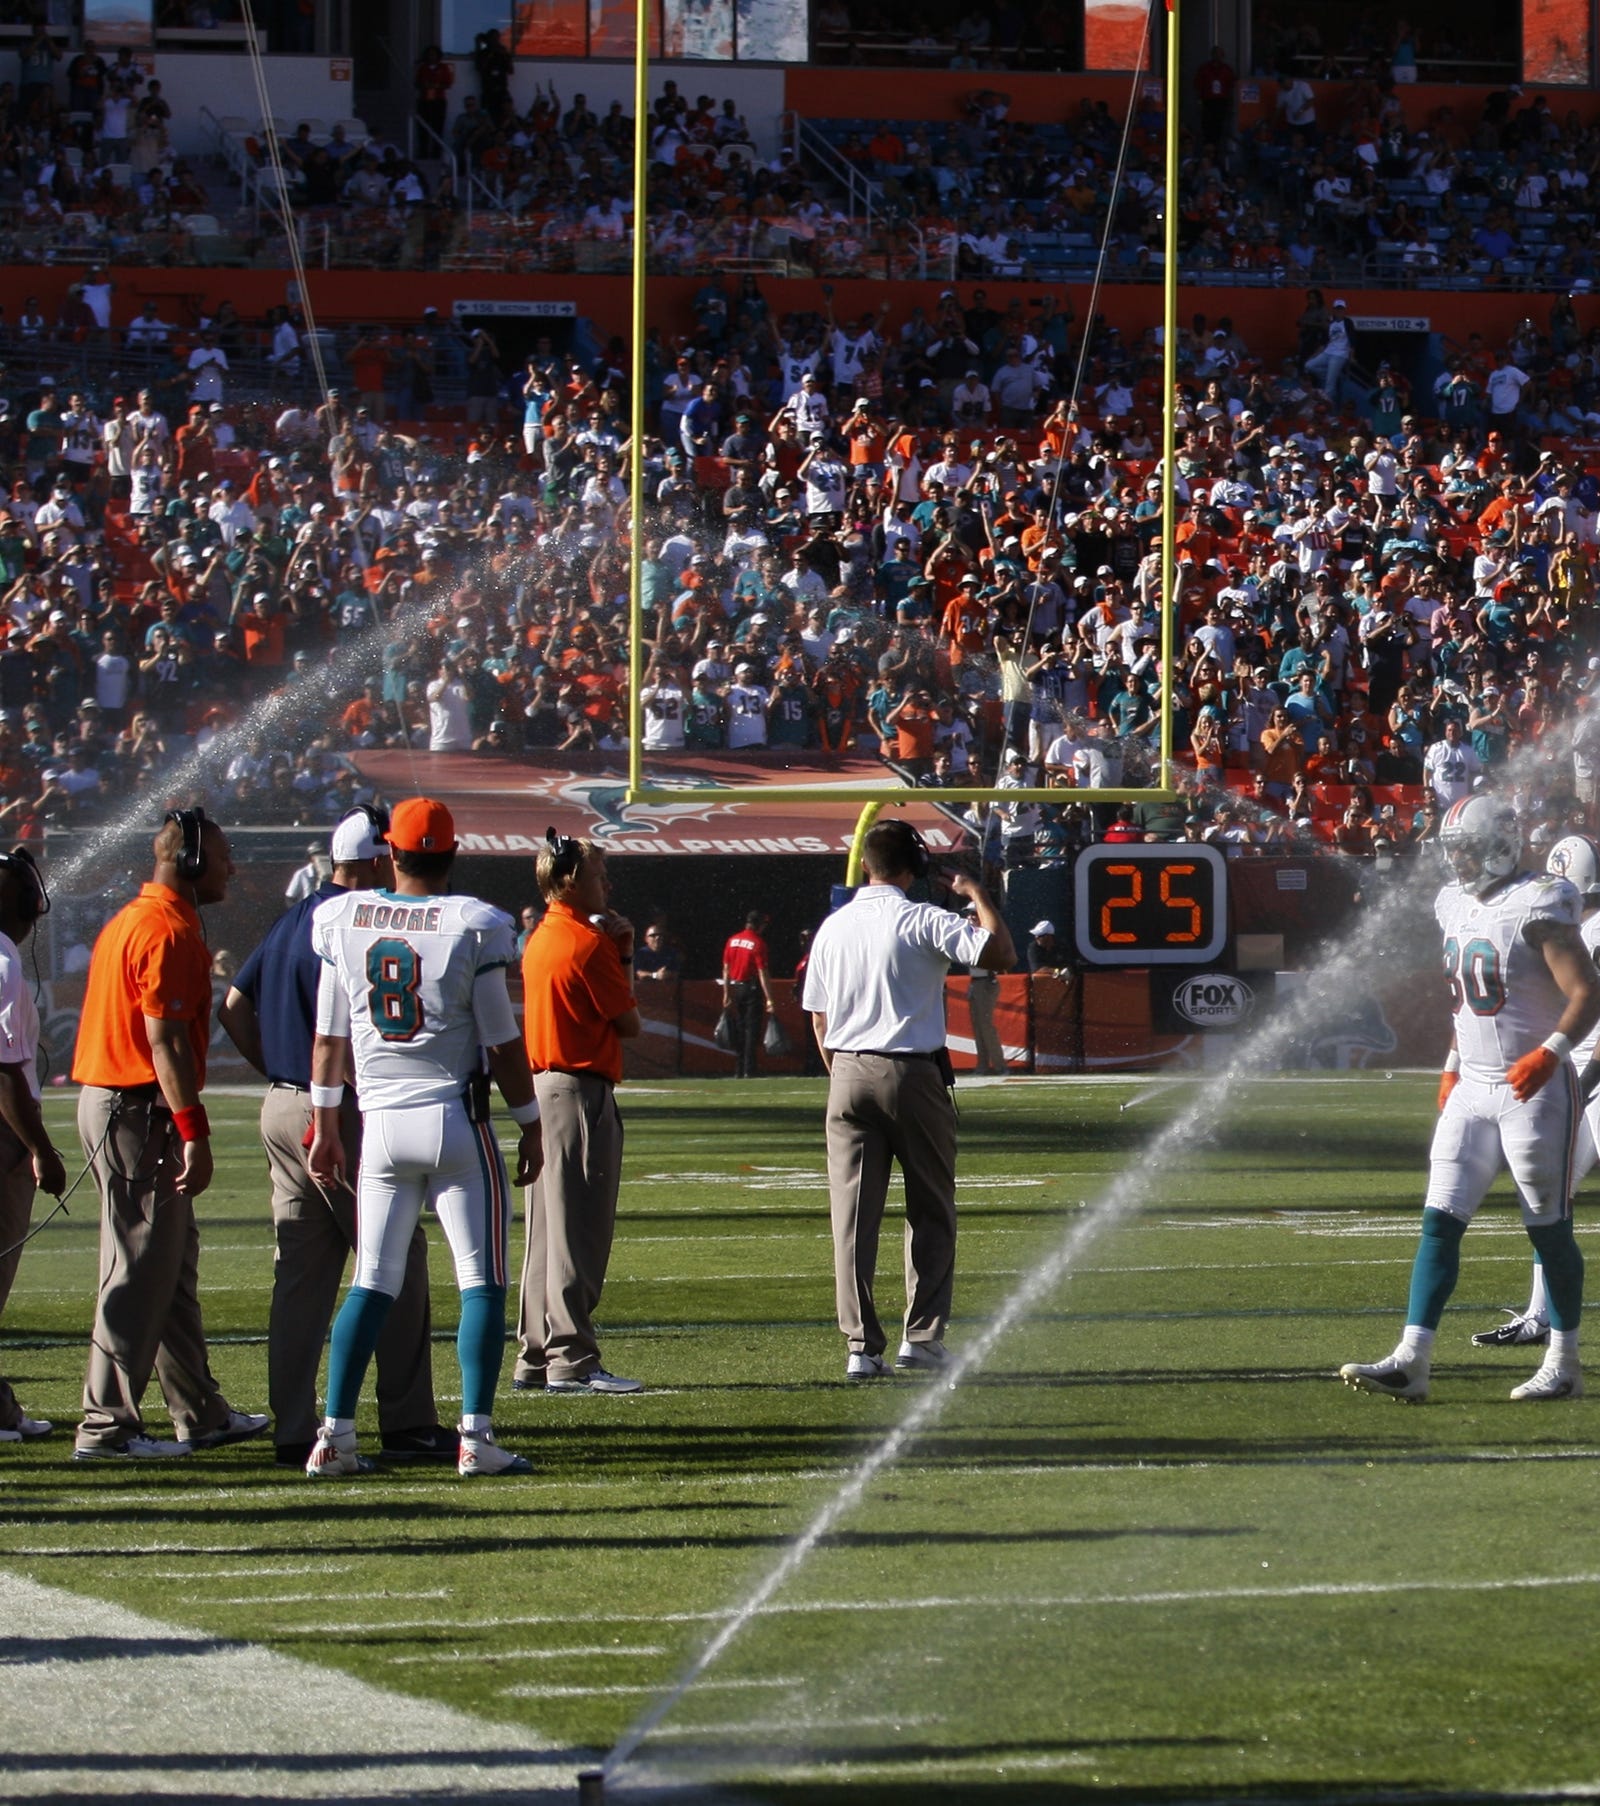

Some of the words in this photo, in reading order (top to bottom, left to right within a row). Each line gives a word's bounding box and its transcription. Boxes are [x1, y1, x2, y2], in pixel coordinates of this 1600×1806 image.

[1390, 319, 1412, 329] 102
[1380, 397, 1395, 414] 17
[1453, 390, 1467, 407] 17
[341, 604, 366, 627] 55
[155, 661, 180, 684] 92
[742, 695, 761, 715] 13
[783, 701, 803, 722] 15
[1443, 762, 1467, 783] 22
[1102, 865, 1201, 942] 25
[352, 903, 442, 932] MOORE
[366, 936, 425, 1042] 8
[1190, 984, 1238, 1006] FOX
[1190, 1006, 1238, 1016] SPORTS
